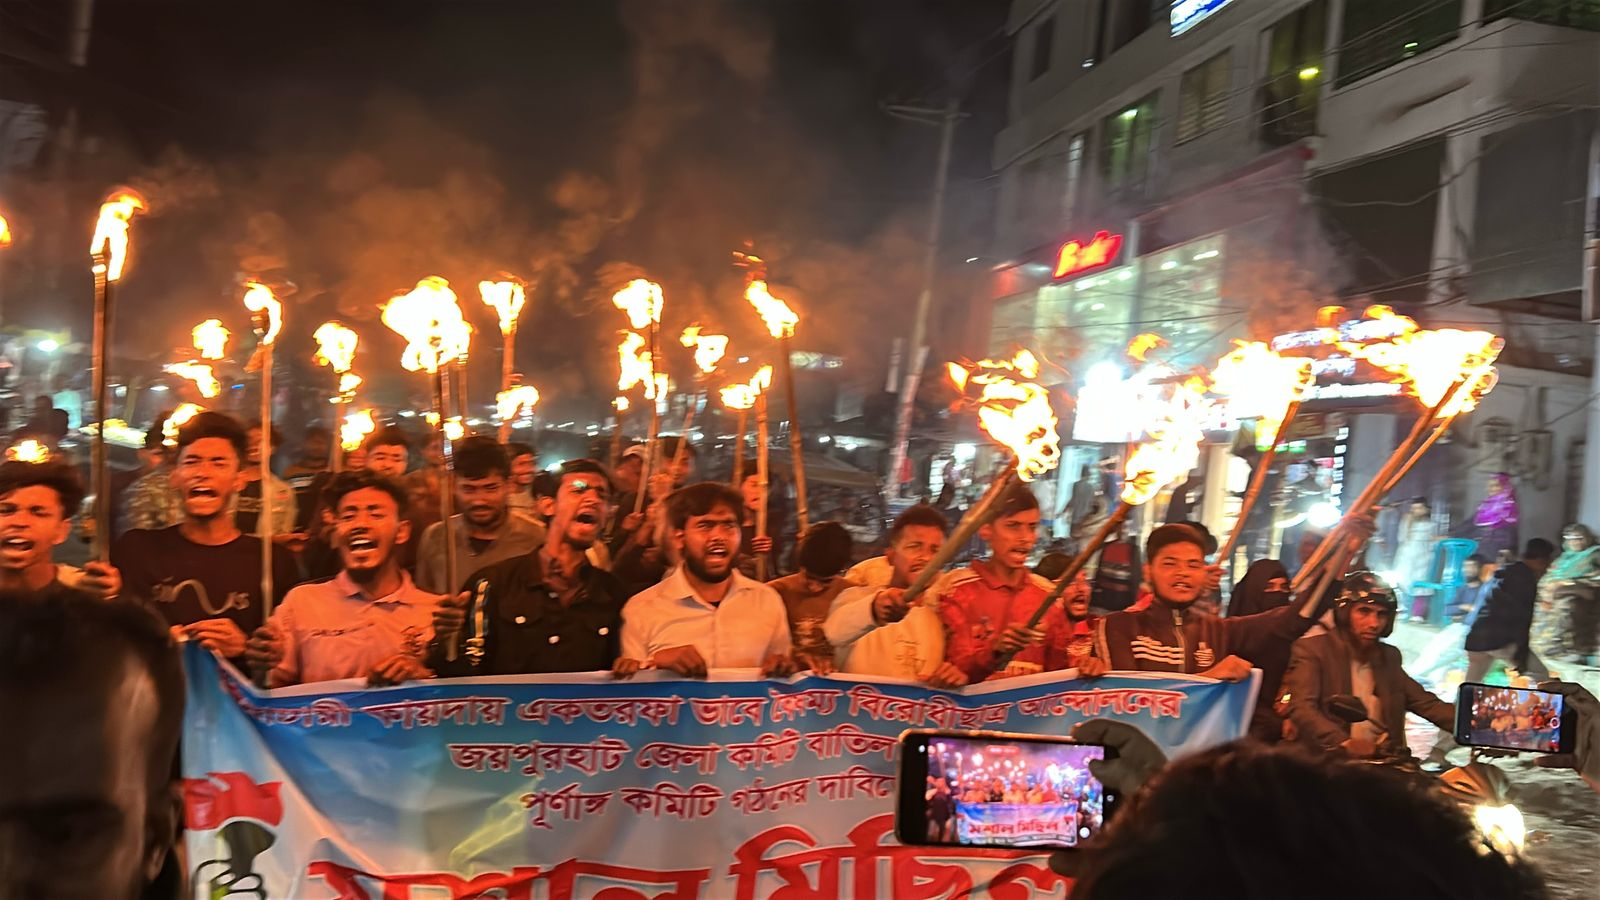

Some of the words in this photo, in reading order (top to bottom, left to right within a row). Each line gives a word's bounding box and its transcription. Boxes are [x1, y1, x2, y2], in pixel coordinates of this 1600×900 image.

[517, 695, 685, 727] একতরফা
[689, 696, 769, 728] ভাবে
[634, 741, 723, 774] জেলা
[725, 728, 801, 770] কমিটি
[619, 781, 724, 820] কমিটি
